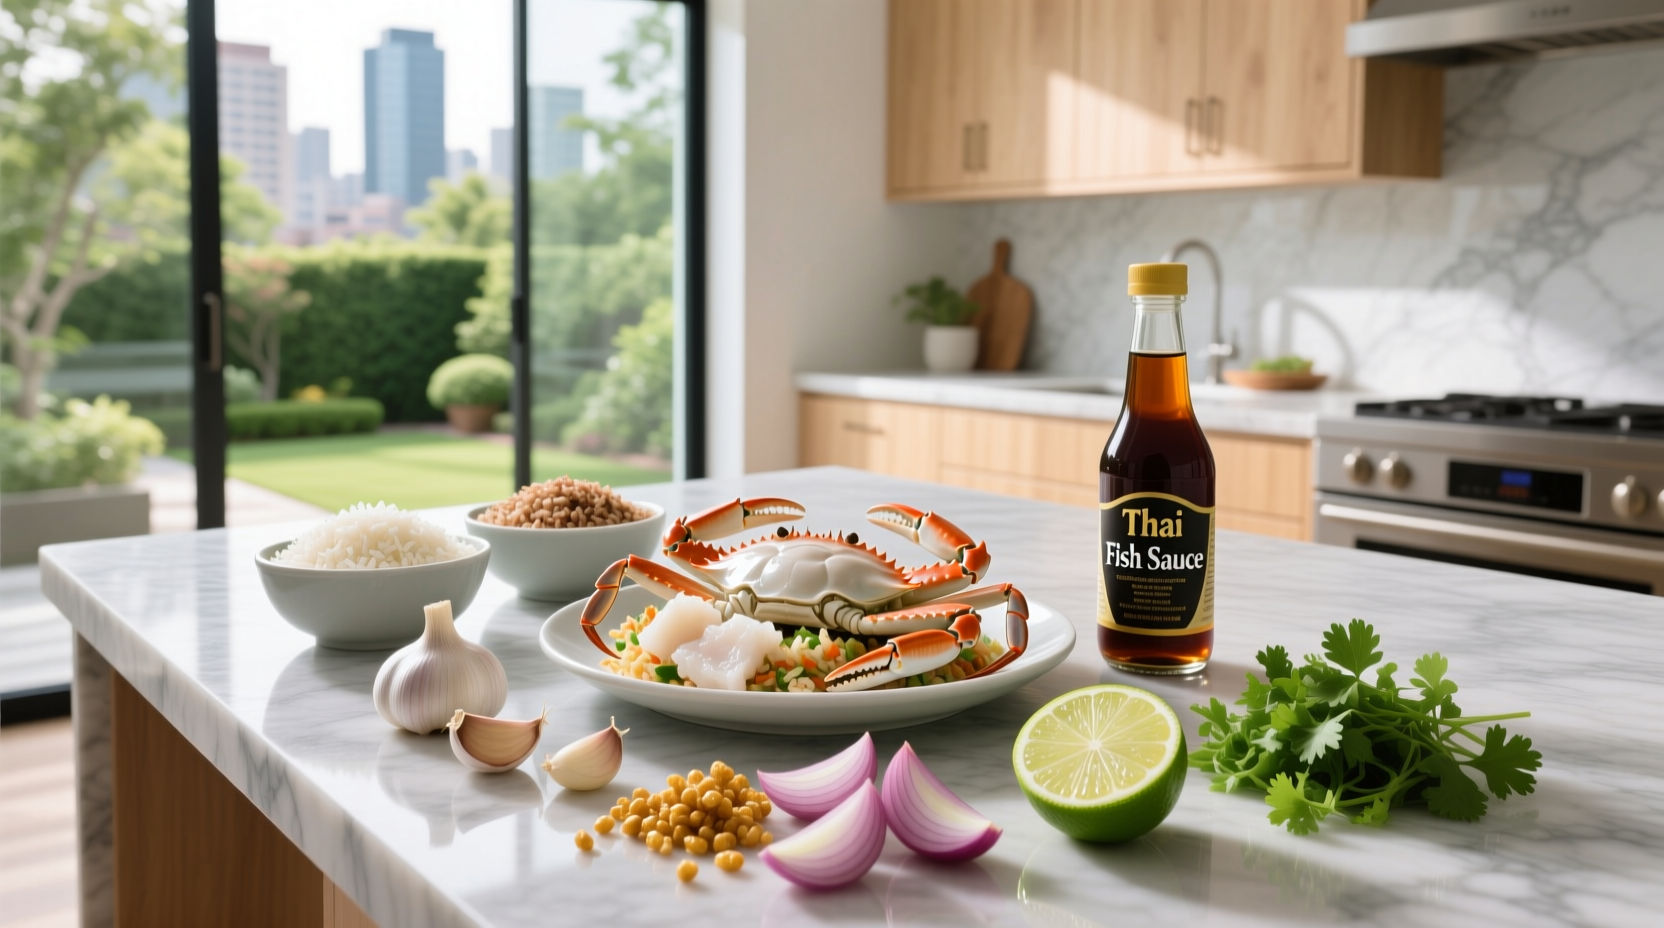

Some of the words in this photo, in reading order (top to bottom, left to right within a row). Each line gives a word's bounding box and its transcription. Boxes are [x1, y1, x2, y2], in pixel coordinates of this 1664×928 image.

[1122, 508, 1183, 538] Thai
[1105, 541, 1143, 569] Fish
[1147, 546, 1204, 571] Sauce
